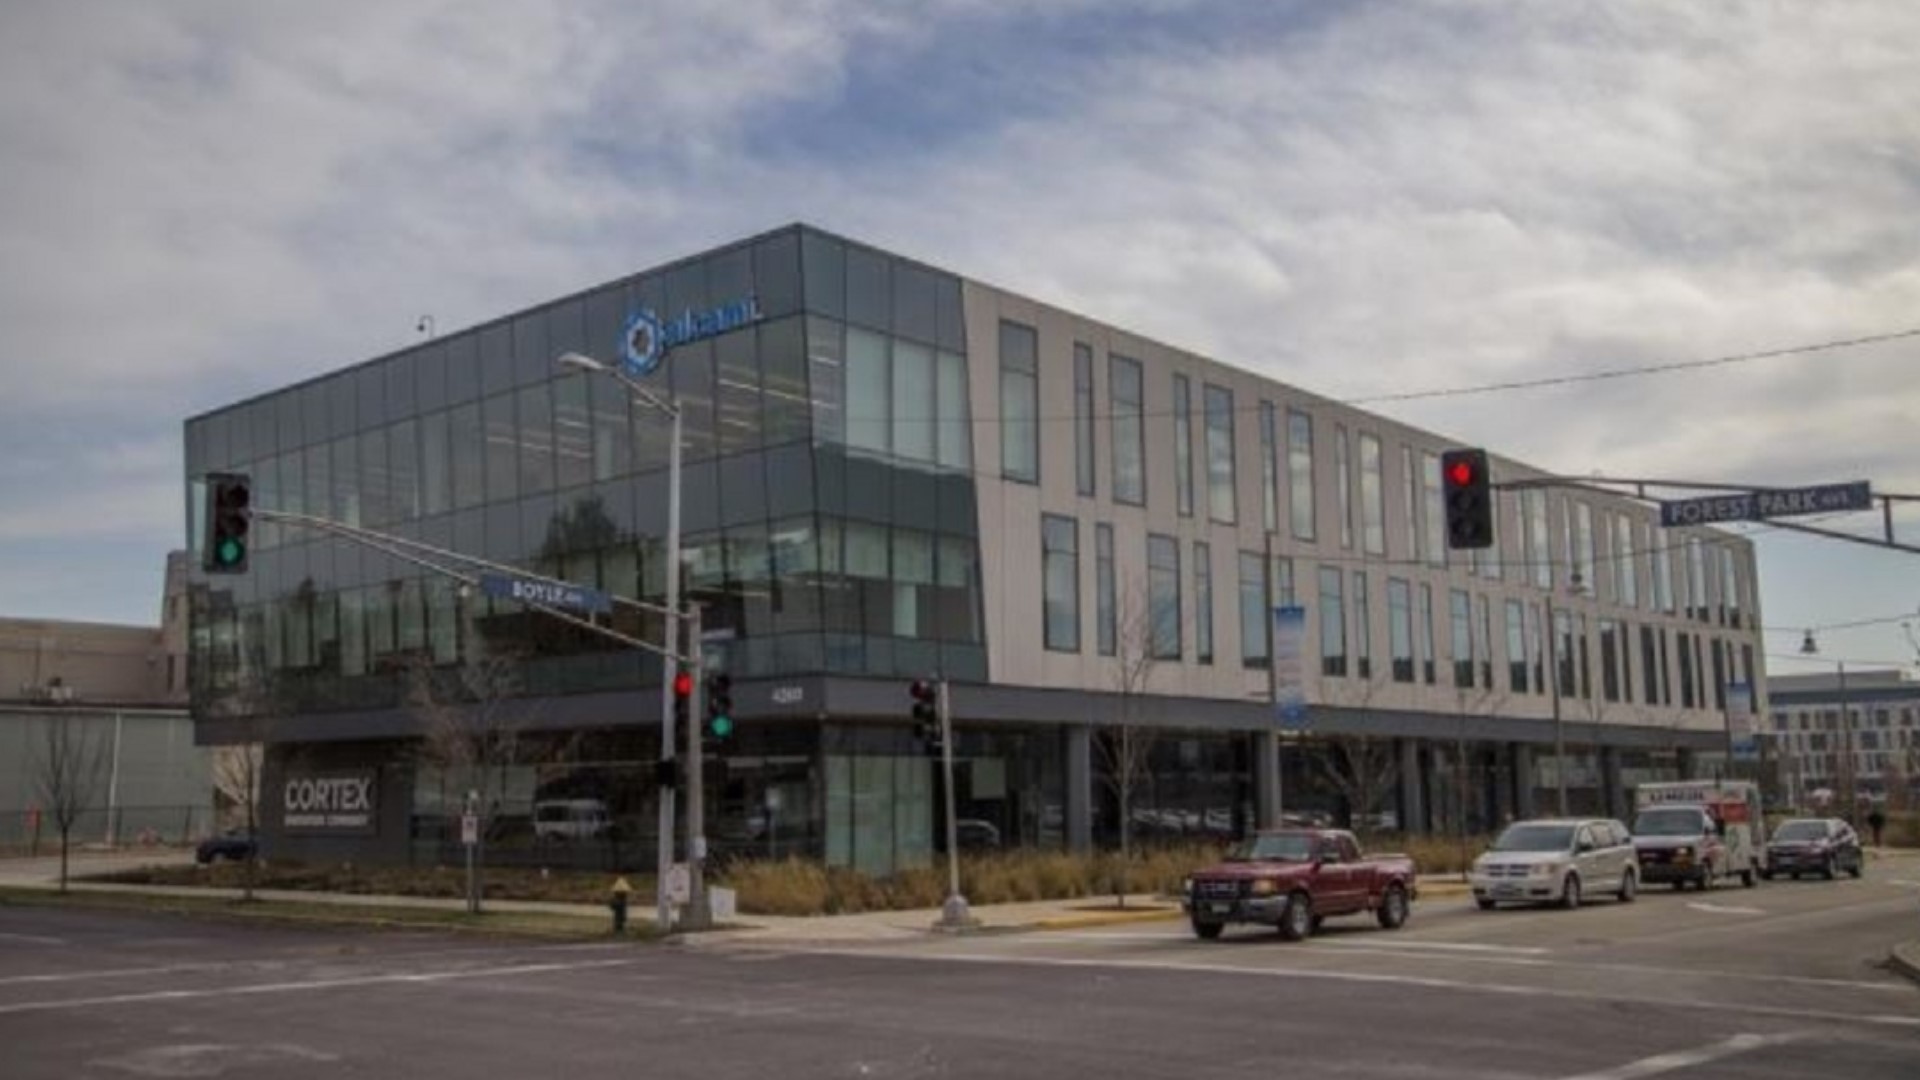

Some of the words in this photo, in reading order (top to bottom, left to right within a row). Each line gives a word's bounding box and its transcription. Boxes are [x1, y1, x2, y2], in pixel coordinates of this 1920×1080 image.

[1670, 496, 1751, 522] FOREST
[1758, 490, 1817, 513] PARK
[512, 580, 564, 602] BOYLE
[285, 778, 370, 811] CORTEX
